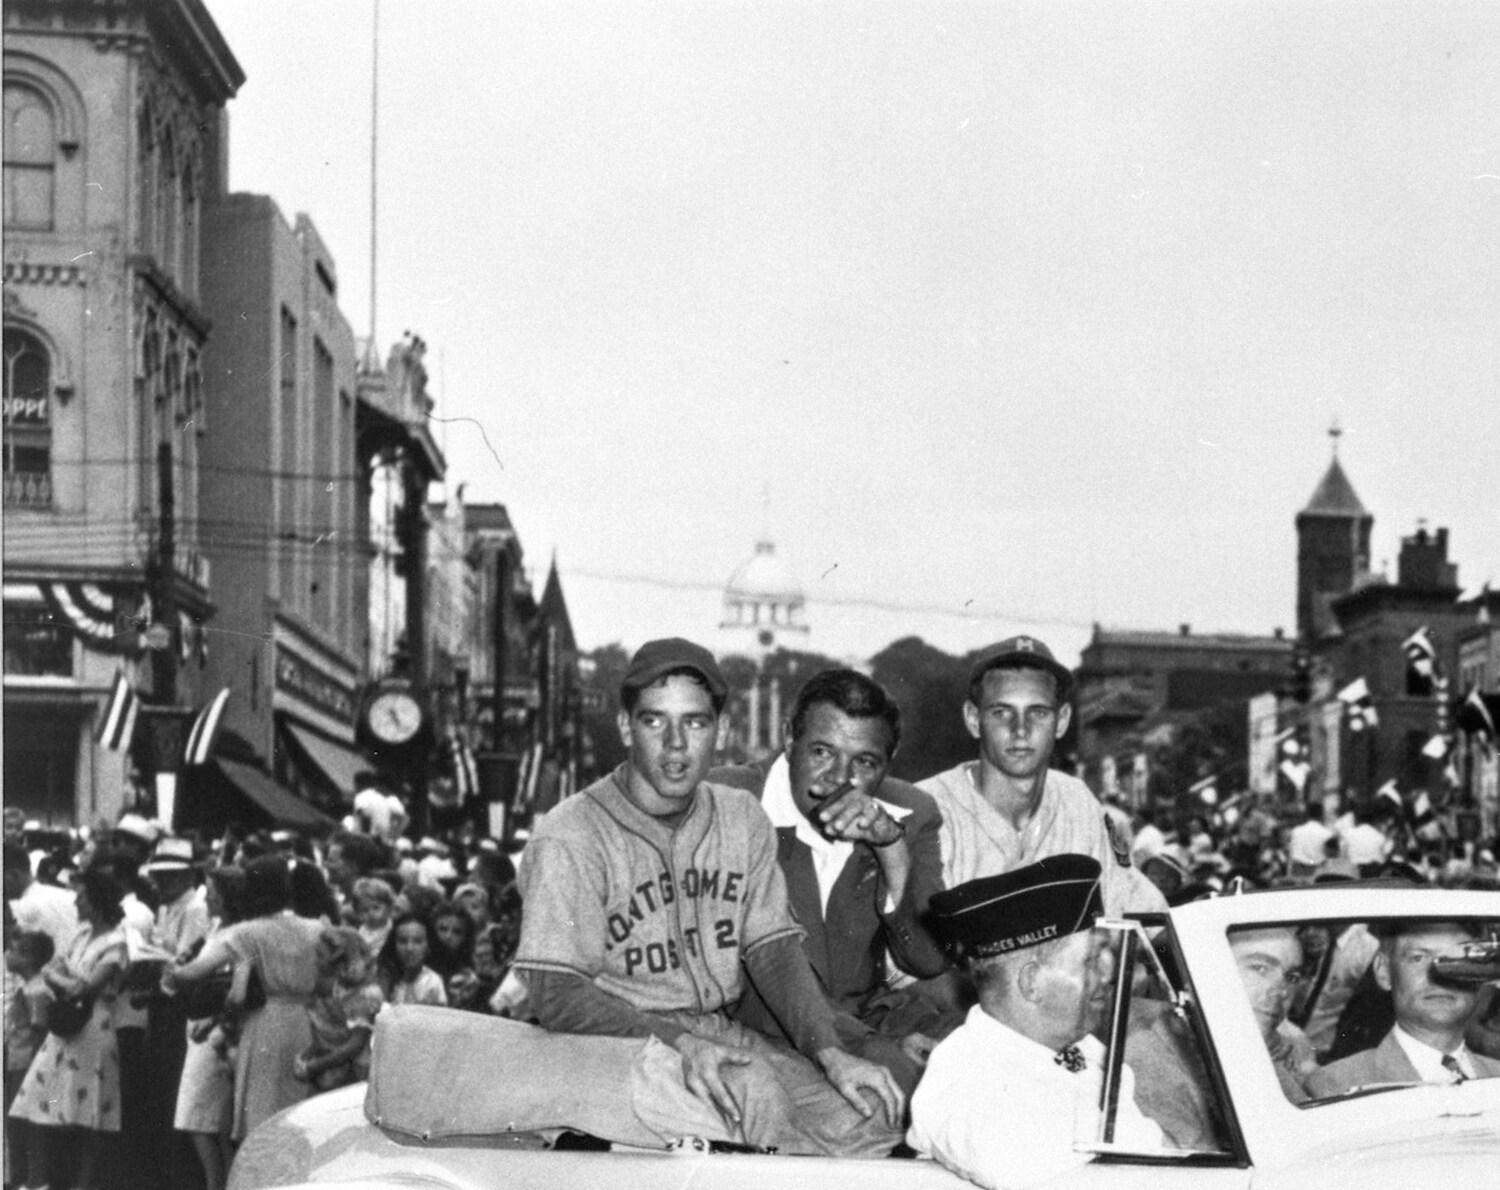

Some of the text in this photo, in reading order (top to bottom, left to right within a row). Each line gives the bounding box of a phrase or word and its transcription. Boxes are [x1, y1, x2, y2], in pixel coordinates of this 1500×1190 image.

[1016, 637, 1035, 651] M
[605, 868, 749, 951] ONTGOME
[624, 918, 739, 976] POST 2
[1016, 923, 1058, 946] VALLEY
